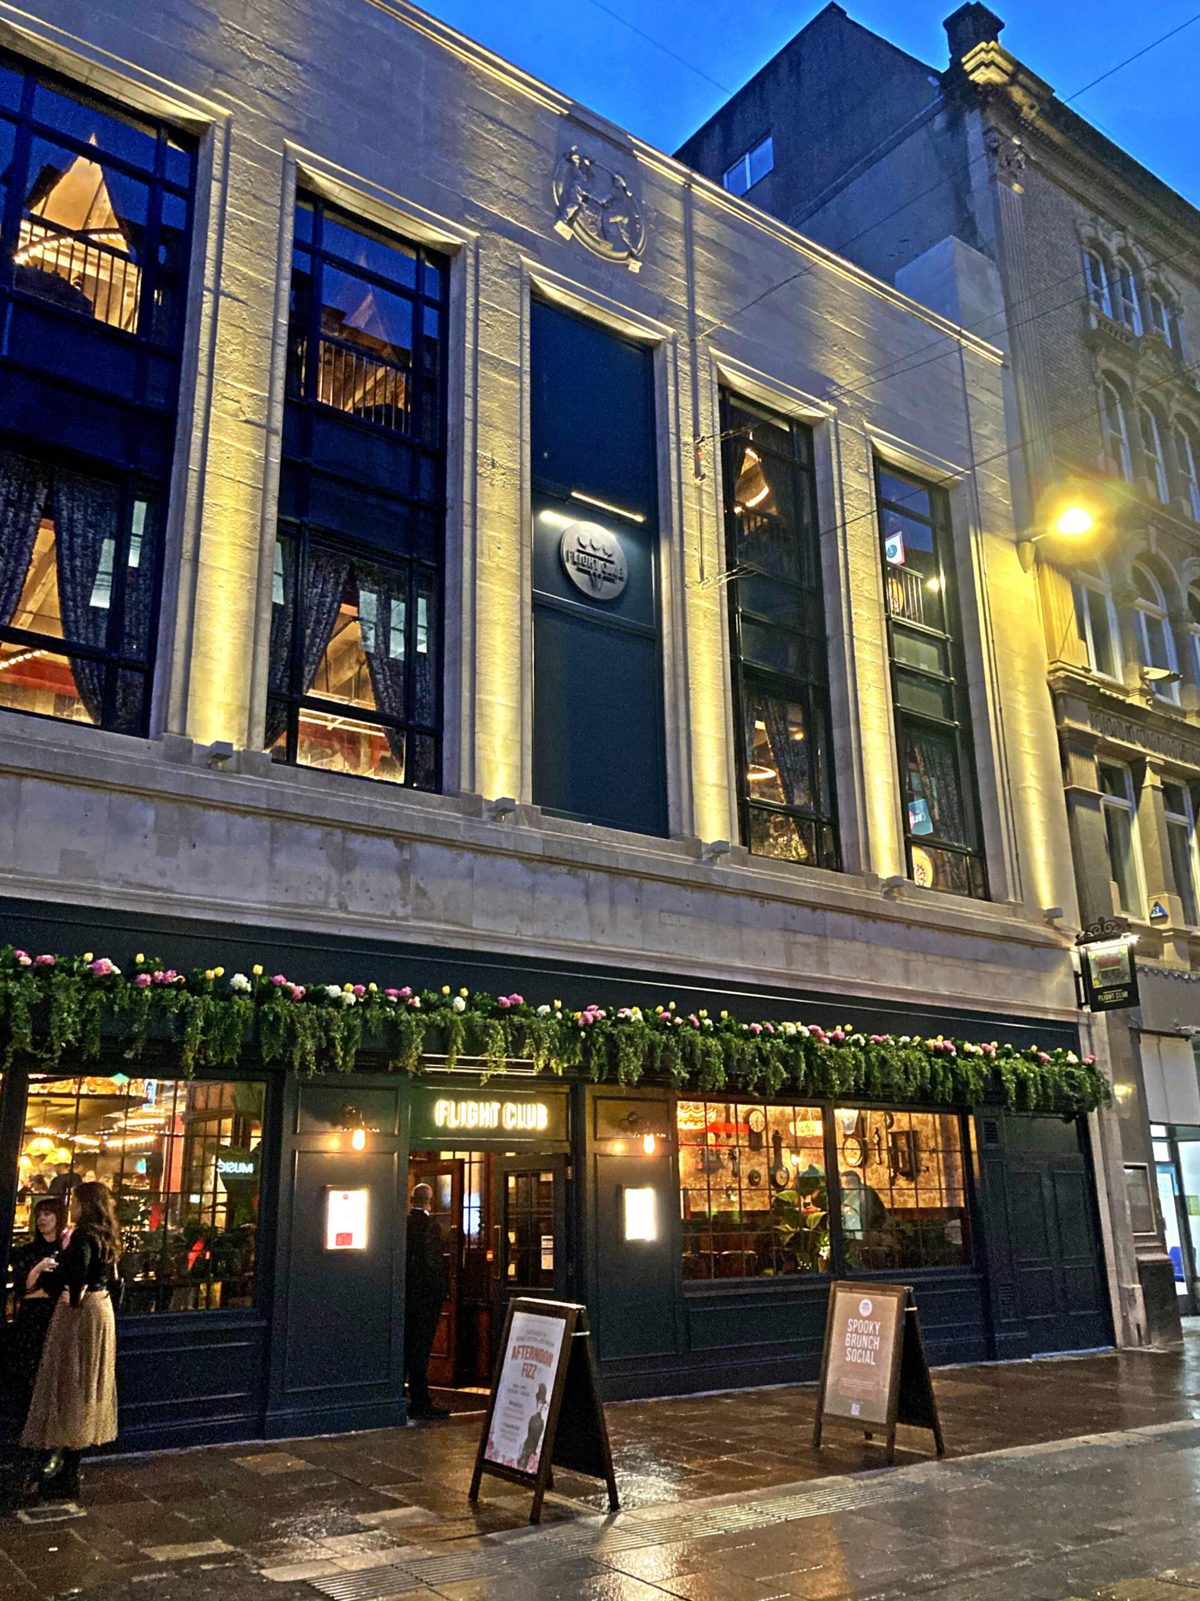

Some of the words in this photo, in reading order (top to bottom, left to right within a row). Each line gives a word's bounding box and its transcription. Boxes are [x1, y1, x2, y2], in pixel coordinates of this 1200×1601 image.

[434, 1099, 501, 1128] FLIGHT
[502, 1102, 548, 1130] CLUB
[847, 1318, 881, 1336] SPOOKY
[845, 1333, 880, 1350] BRUNCH
[511, 1344, 554, 1368] AFTERNOON
[845, 1348, 876, 1366] SOCIAL
[521, 1362, 538, 1379] FIZZ
